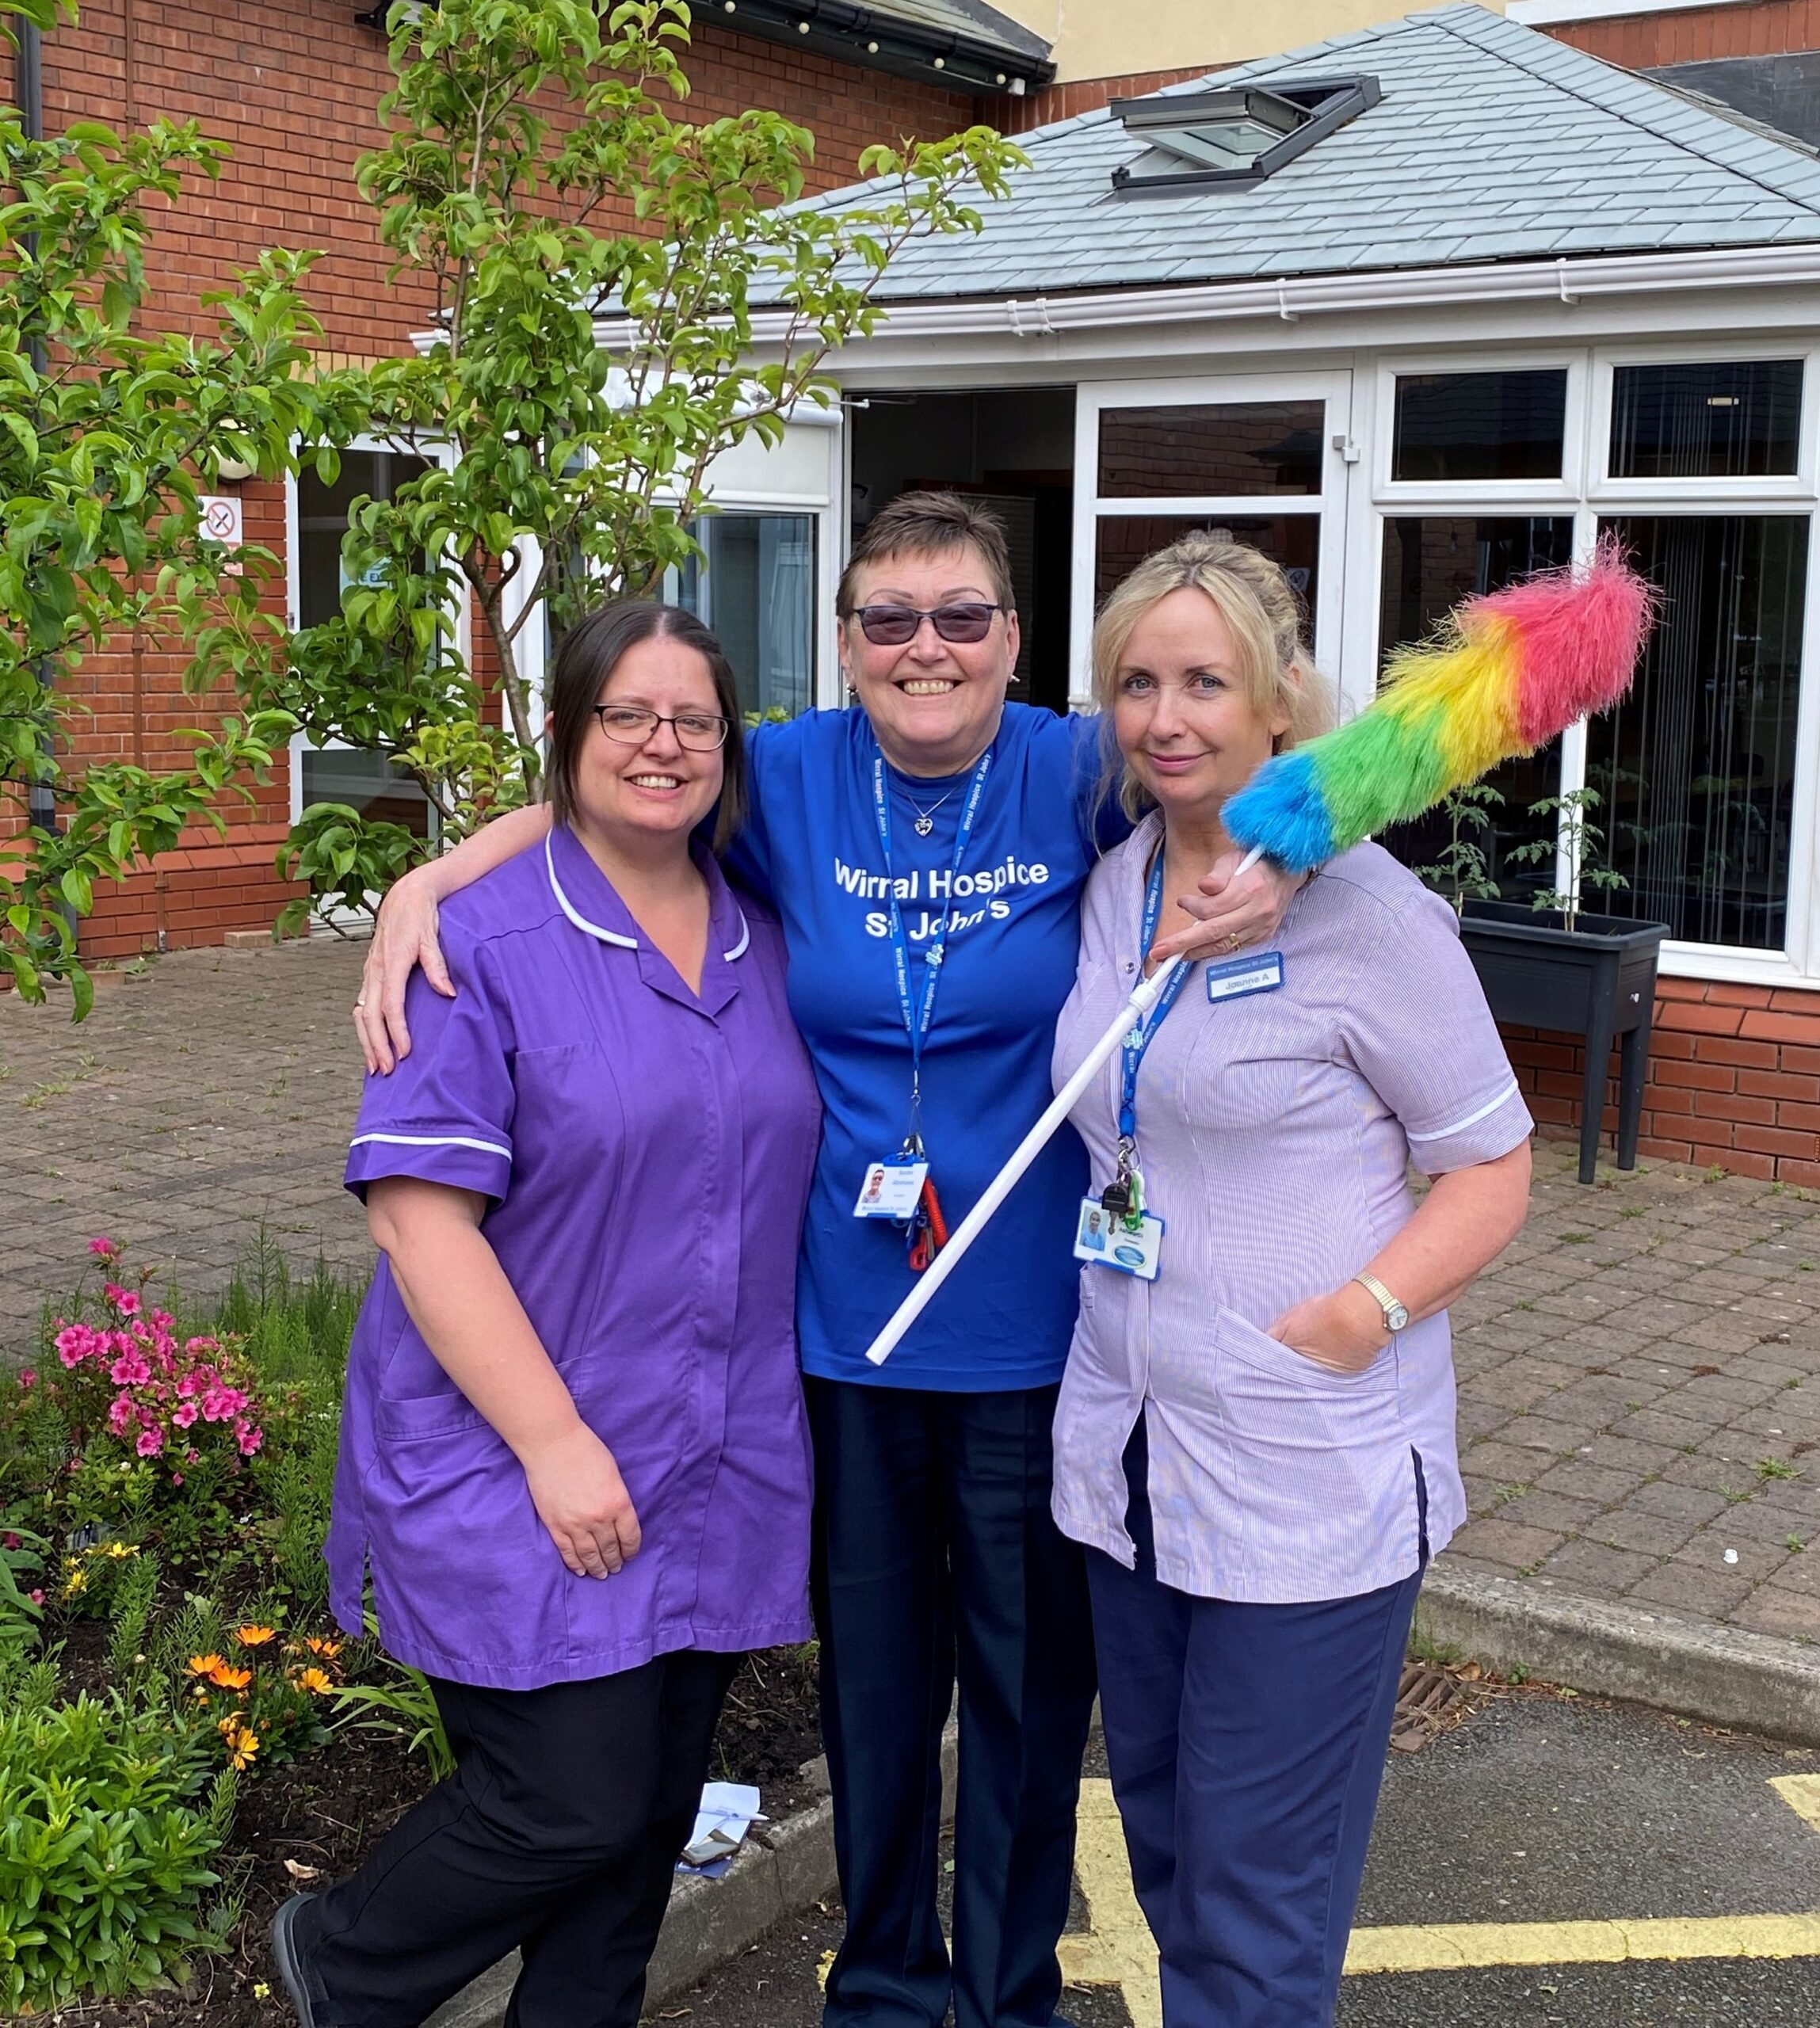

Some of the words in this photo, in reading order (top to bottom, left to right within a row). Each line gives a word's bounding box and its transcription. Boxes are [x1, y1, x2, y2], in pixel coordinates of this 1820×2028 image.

[963, 810, 975, 831] Wirral
[969, 783, 982, 810] Hospice
[834, 856, 919, 899] Wirral
[929, 856, 1050, 899] Hospice
[910, 898, 1011, 940] John's
[895, 946, 905, 968] Wirral
[1261, 973, 1269, 982] A
[1162, 984, 1176, 1005] Wirral
[1172, 960, 1189, 987] Hospic
